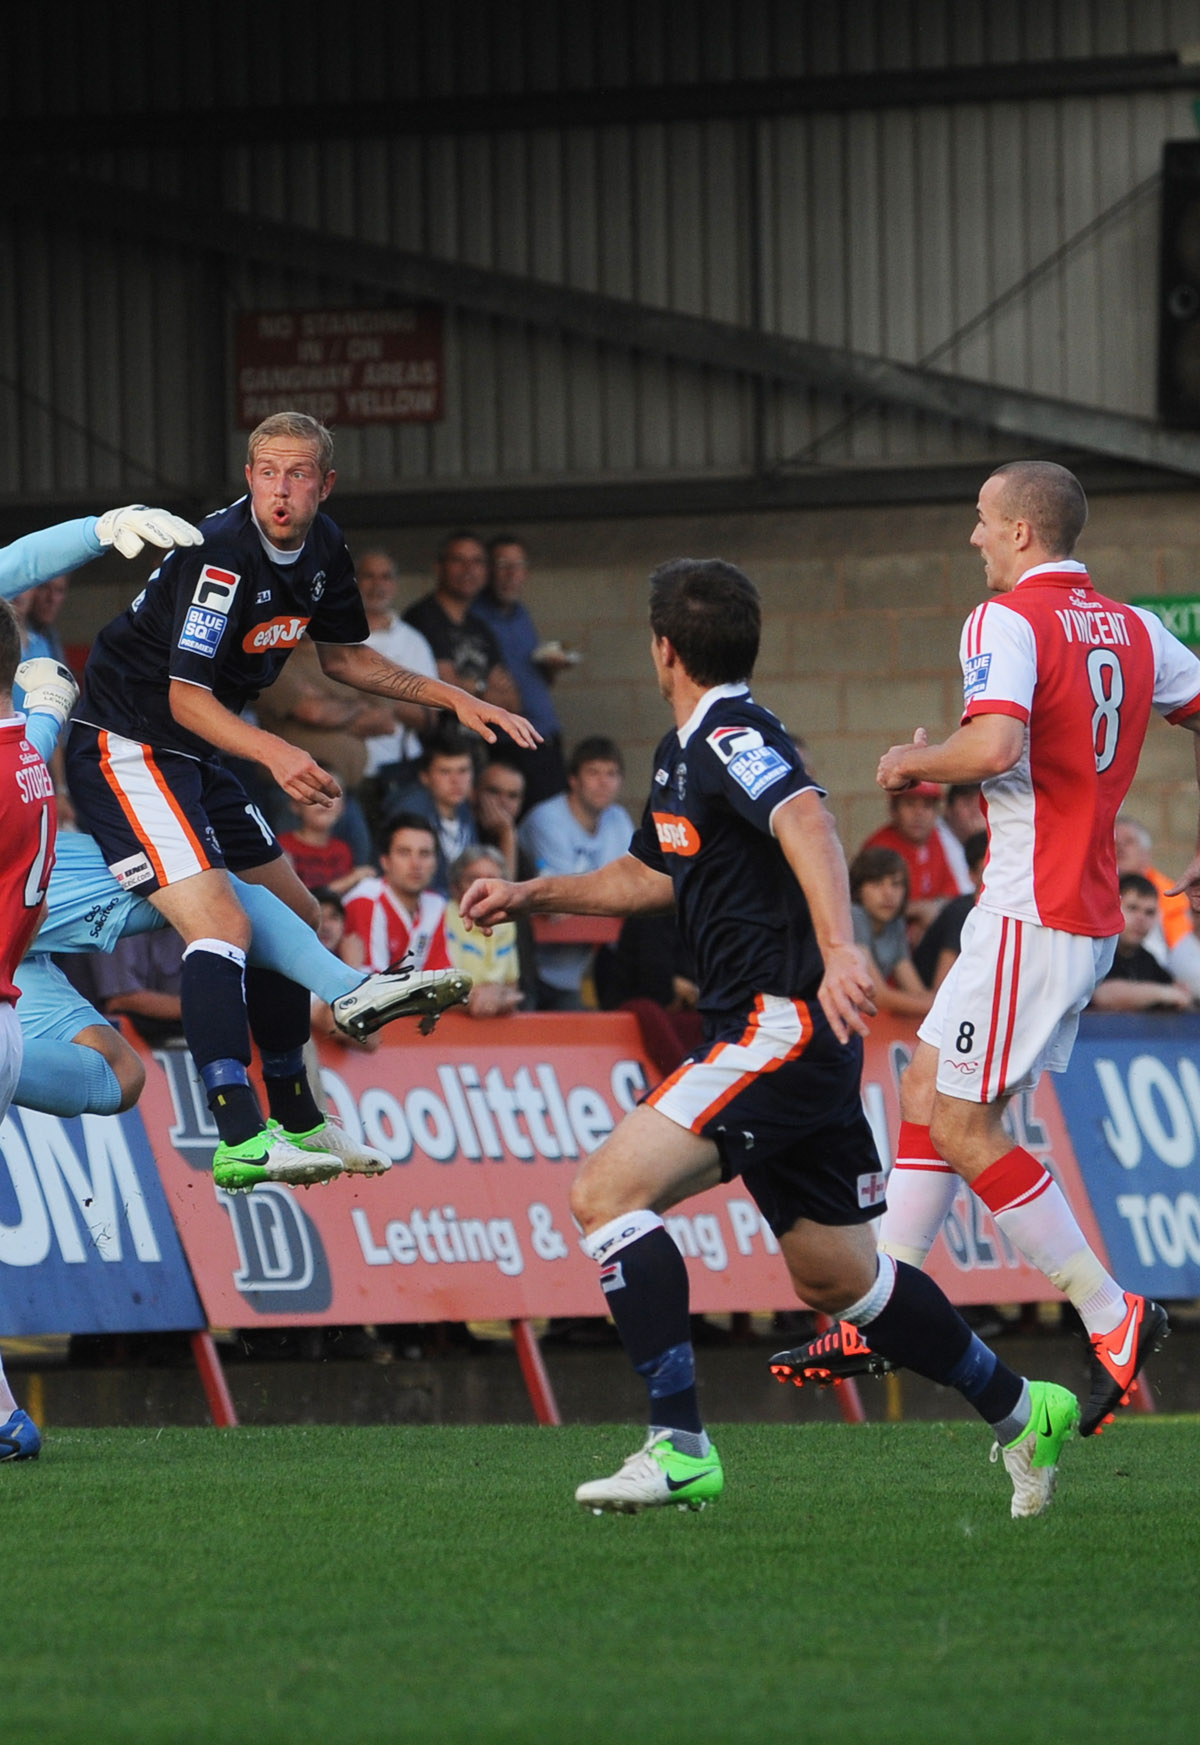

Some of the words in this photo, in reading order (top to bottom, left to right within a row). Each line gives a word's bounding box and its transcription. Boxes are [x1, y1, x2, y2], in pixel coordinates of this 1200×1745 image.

[185, 622, 208, 640] SQ
[189, 610, 224, 631] BLUE
[1056, 608, 1131, 646] VINCENT
[1087, 647, 1124, 774] 8
[731, 746, 771, 777] BLUE
[955, 1021, 975, 1054] 8
[351, 1205, 525, 1277] Letting
[528, 1202, 568, 1261] &
